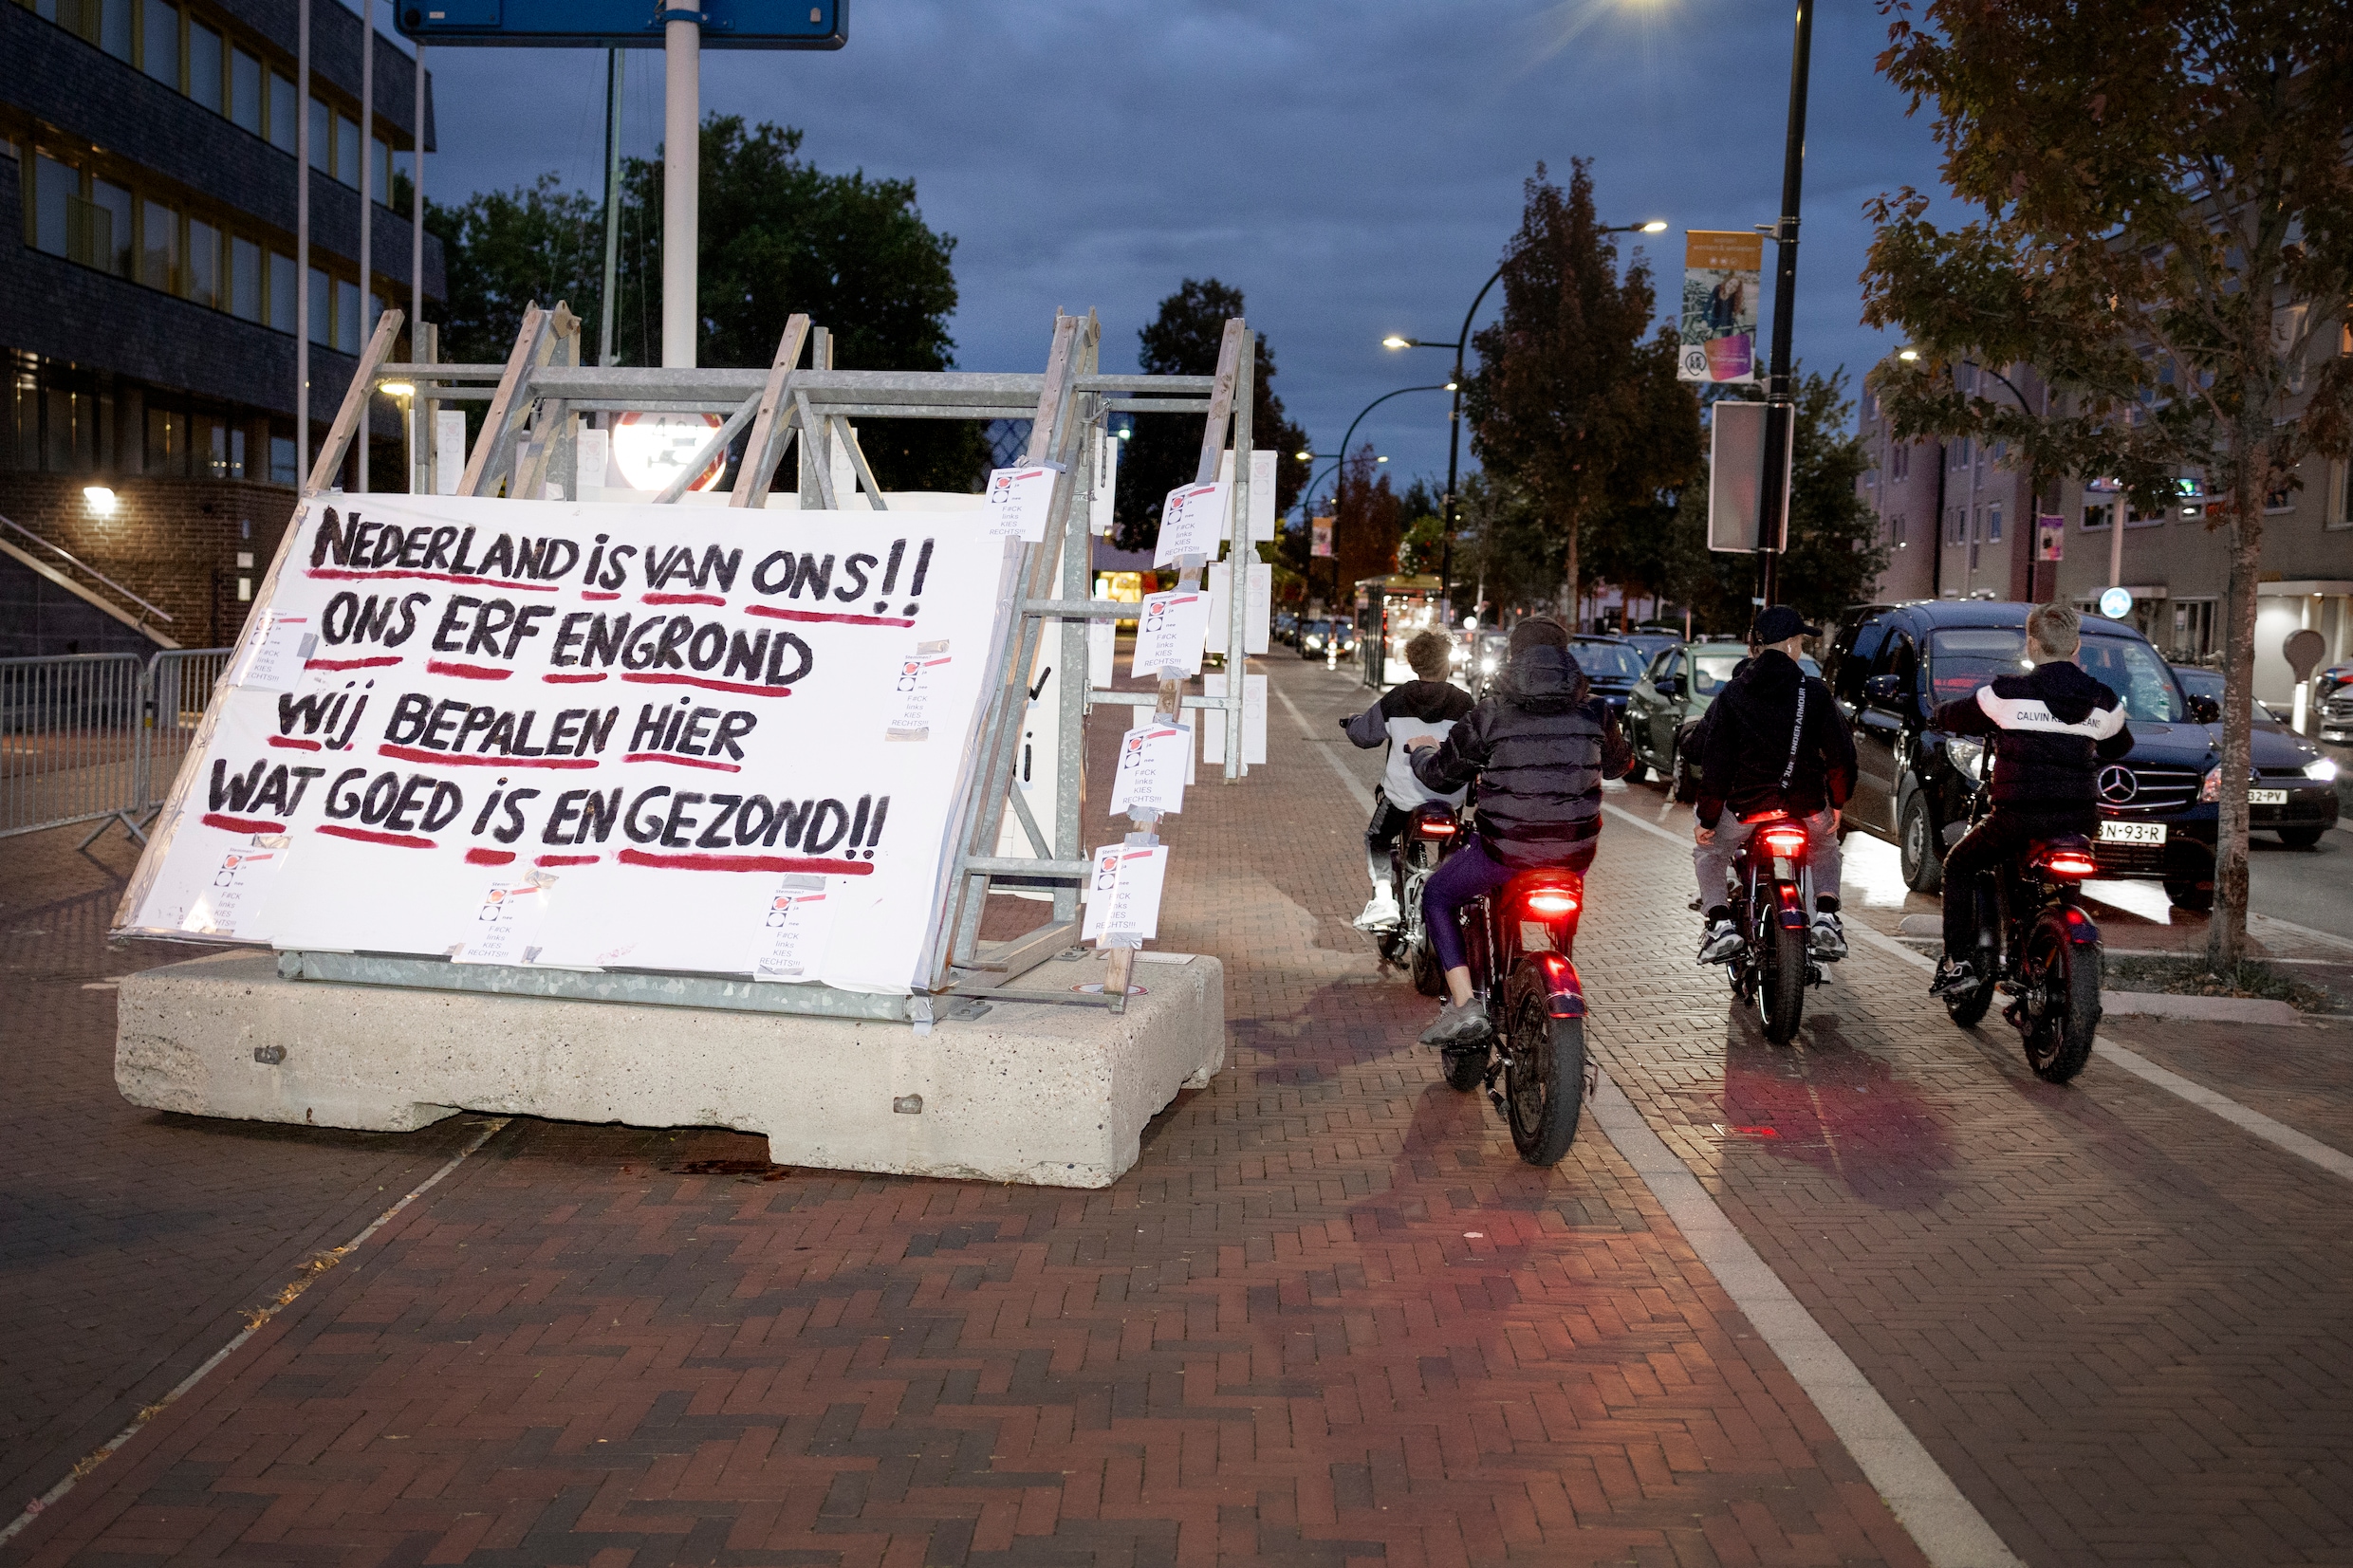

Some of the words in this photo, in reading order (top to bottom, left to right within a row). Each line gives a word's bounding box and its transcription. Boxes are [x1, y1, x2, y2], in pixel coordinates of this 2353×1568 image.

[1164, 545, 1199, 556] RECHTS!!!
[310, 505, 580, 581] NEDERLAND
[644, 544, 743, 593] VAN
[751, 538, 935, 617] ONS!!
[322, 591, 431, 648] ONS
[432, 595, 556, 659] ERF
[1144, 658, 1181, 667] RECHTS!!!
[246, 673, 279, 682] ECHTS!!!
[1795, 687, 1806, 725] ARMOUR
[384, 692, 620, 757] BEPALEN
[2016, 711, 2049, 722] CALVIN
[2081, 718, 2101, 729] EANS
[1790, 725, 1802, 755] UNDER
[209, 758, 326, 817] WAT
[324, 767, 464, 833] GOED
[1122, 796, 1162, 804] RECHTS!!!
[775, 940, 794, 949] links
[468, 949, 509, 958] RECHTS!!!
[759, 957, 801, 967] RECHTS!!!
